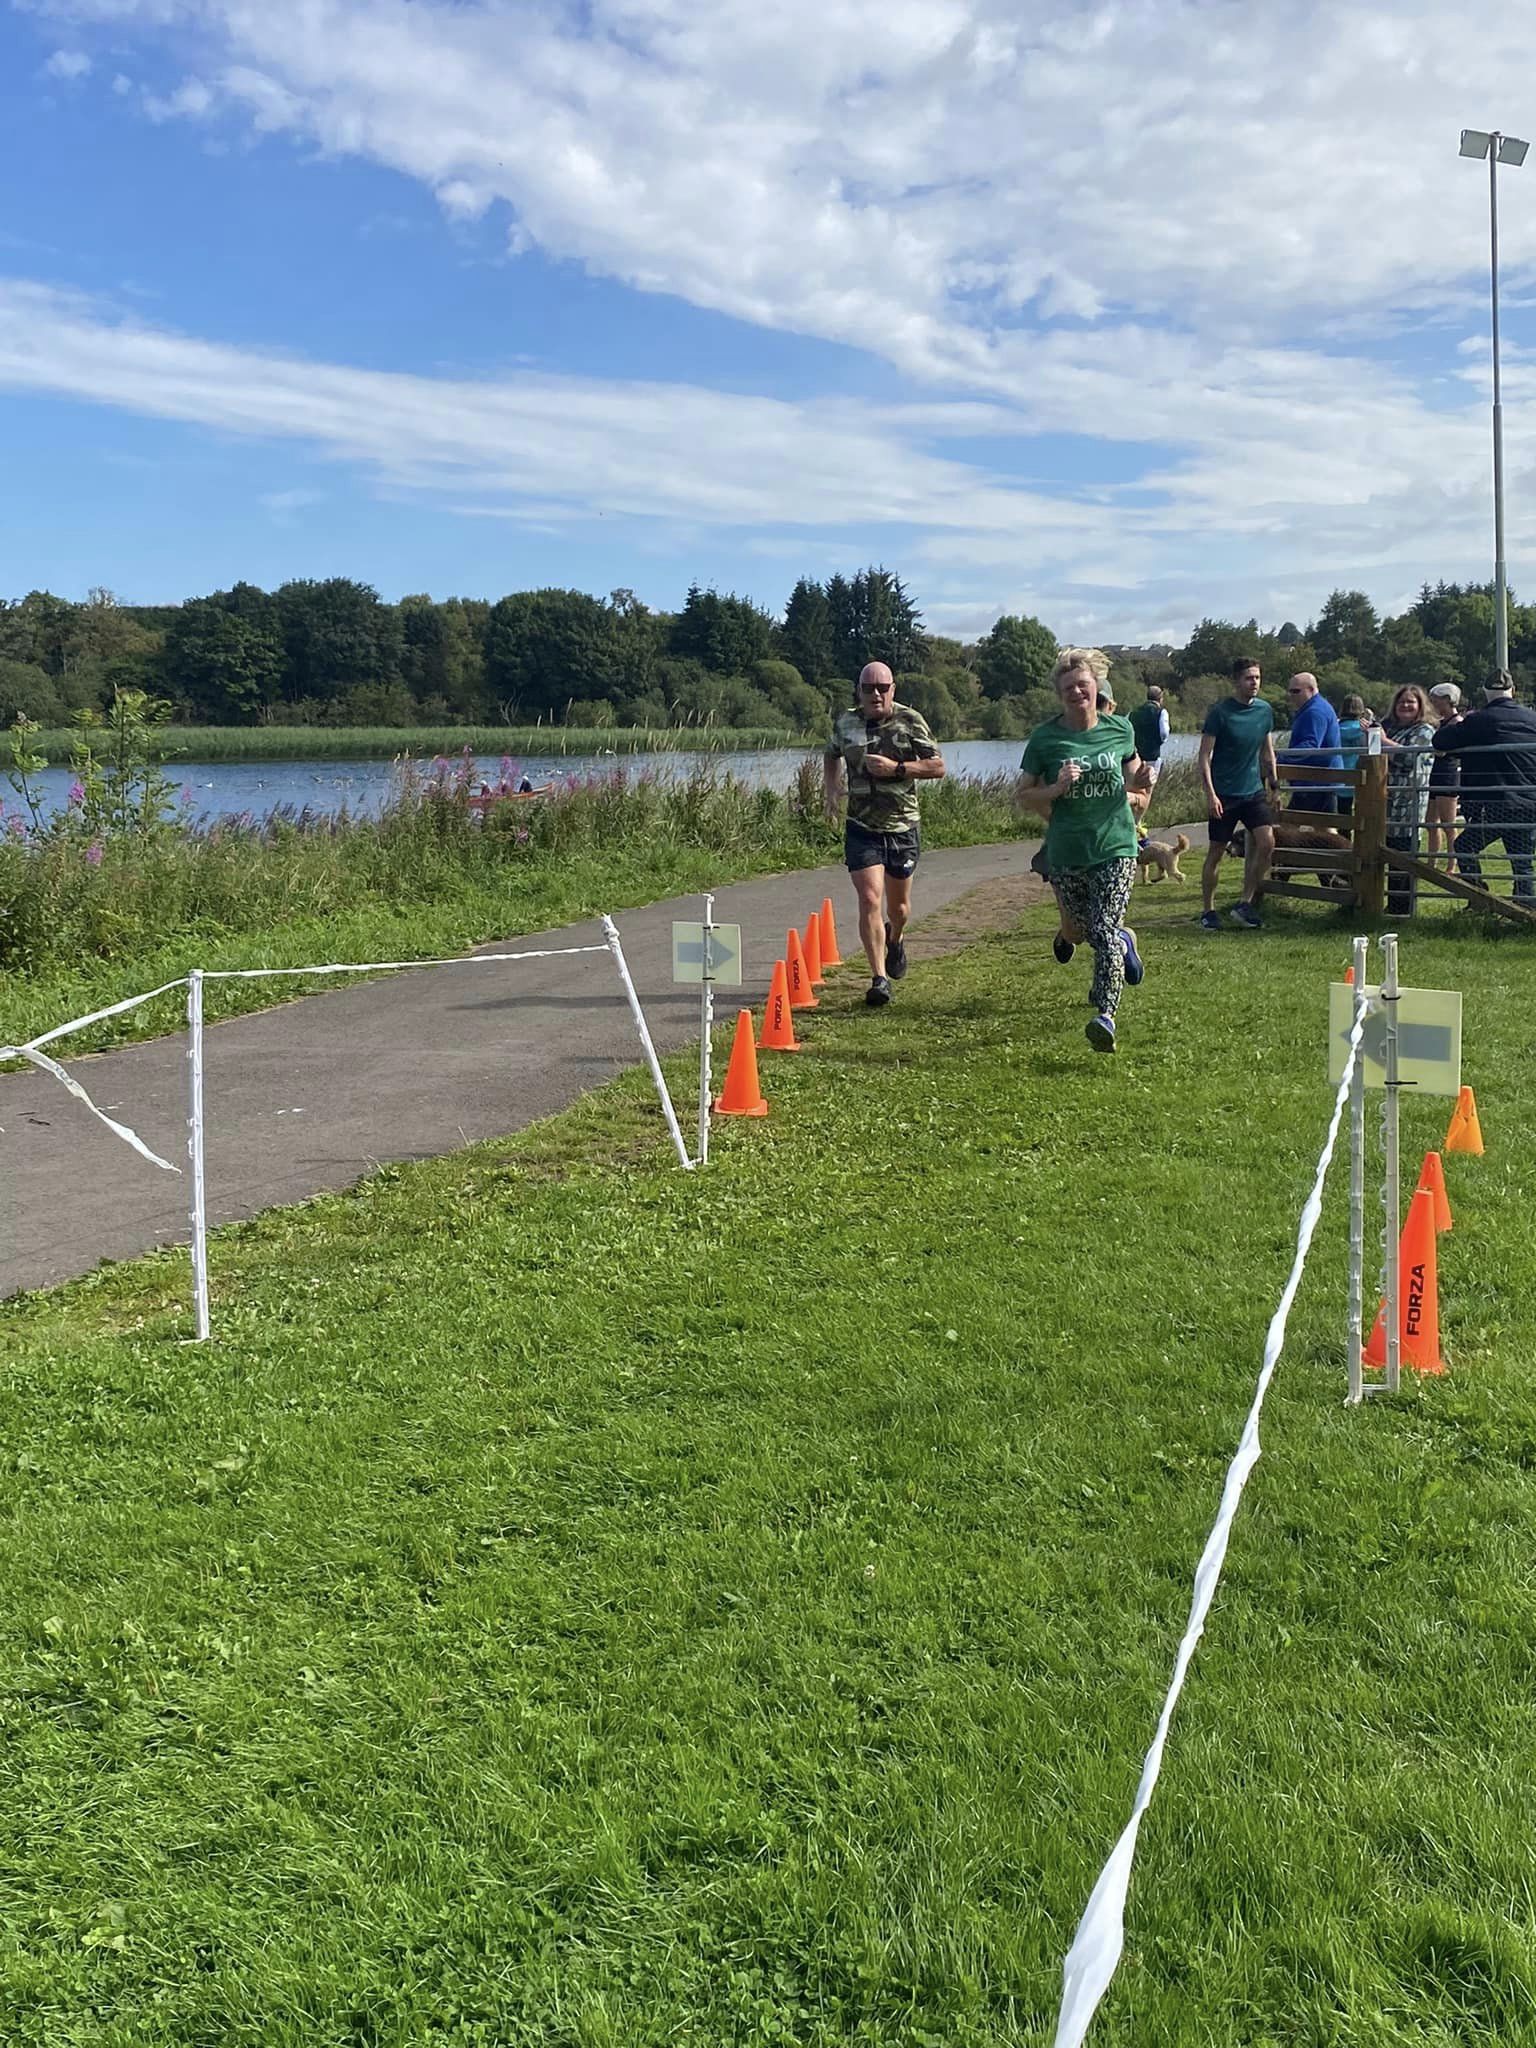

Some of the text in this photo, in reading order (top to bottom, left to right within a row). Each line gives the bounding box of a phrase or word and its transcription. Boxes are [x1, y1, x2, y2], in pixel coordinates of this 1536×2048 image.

[1098, 752, 1118, 769] OK
[1089, 770, 1113, 783] NOT
[1085, 782, 1118, 798] OKAY
[774, 994, 782, 1031] FORZA
[1407, 1264, 1425, 1336] FORZA
